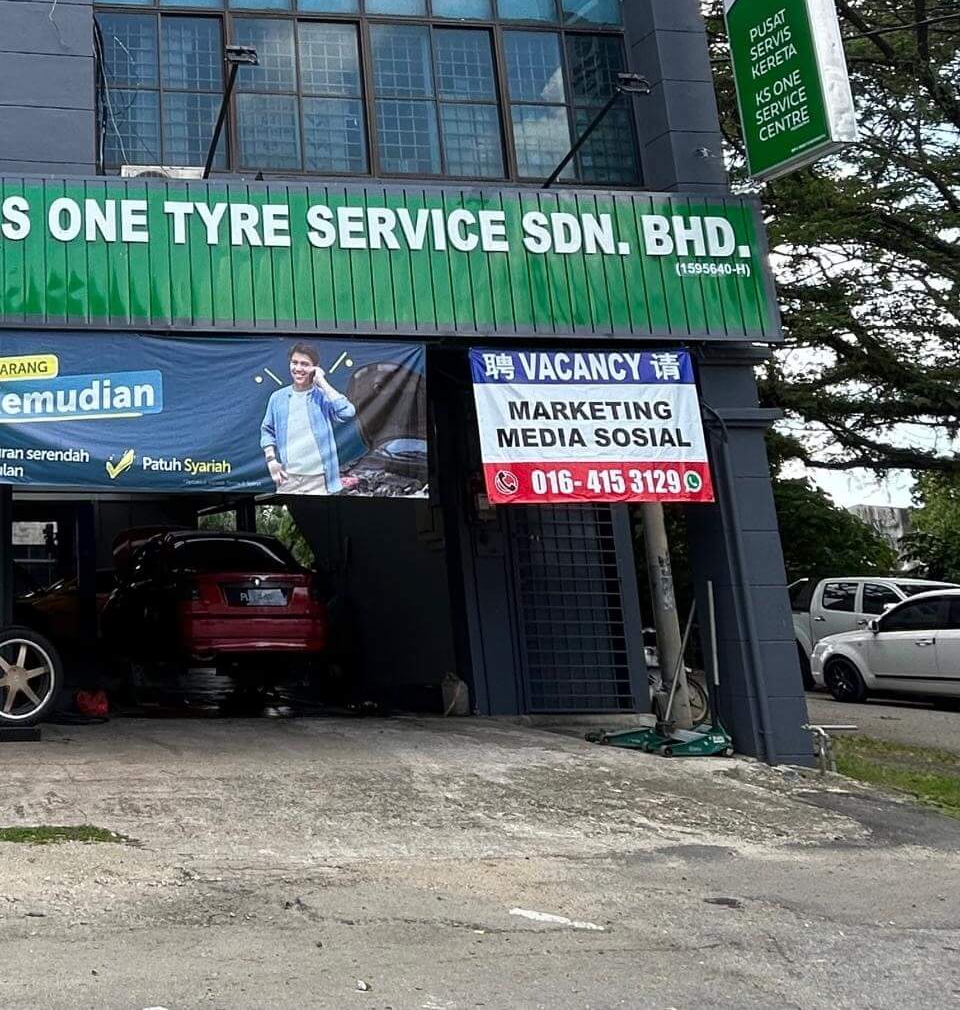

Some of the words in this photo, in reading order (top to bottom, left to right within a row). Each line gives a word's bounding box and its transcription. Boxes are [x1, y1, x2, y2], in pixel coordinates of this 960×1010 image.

[749, 8, 787, 42] PUSAT
[749, 26, 792, 61] SERVIS
[752, 43, 797, 79] KERETA
[756, 88, 771, 106] KS
[774, 69, 801, 96] ONE
[756, 87, 807, 125] SERVICE
[759, 106, 810, 141] CENTRE
[48, 197, 149, 243] ONE
[164, 200, 291, 247] TYRE
[306, 204, 509, 253] SERVICE
[521, 211, 630, 255] SDN.
[641, 214, 751, 258] BHD.
[675, 262, 751, 277] (1595640-H)
[483, 353, 515, 381] 聘
[518, 353, 641, 381] VACANCY
[650, 353, 681, 381] 请
[508, 401, 672, 420] MARKETING
[496, 428, 587, 448] MEDIA
[595, 428, 691, 448] SOSIAL
[26, 447, 90, 463] serendah
[143, 456, 182, 472] Patuh
[184, 460, 231, 475] Syariah
[587, 470, 623, 494] 415
[628, 469, 681, 494] 3129
